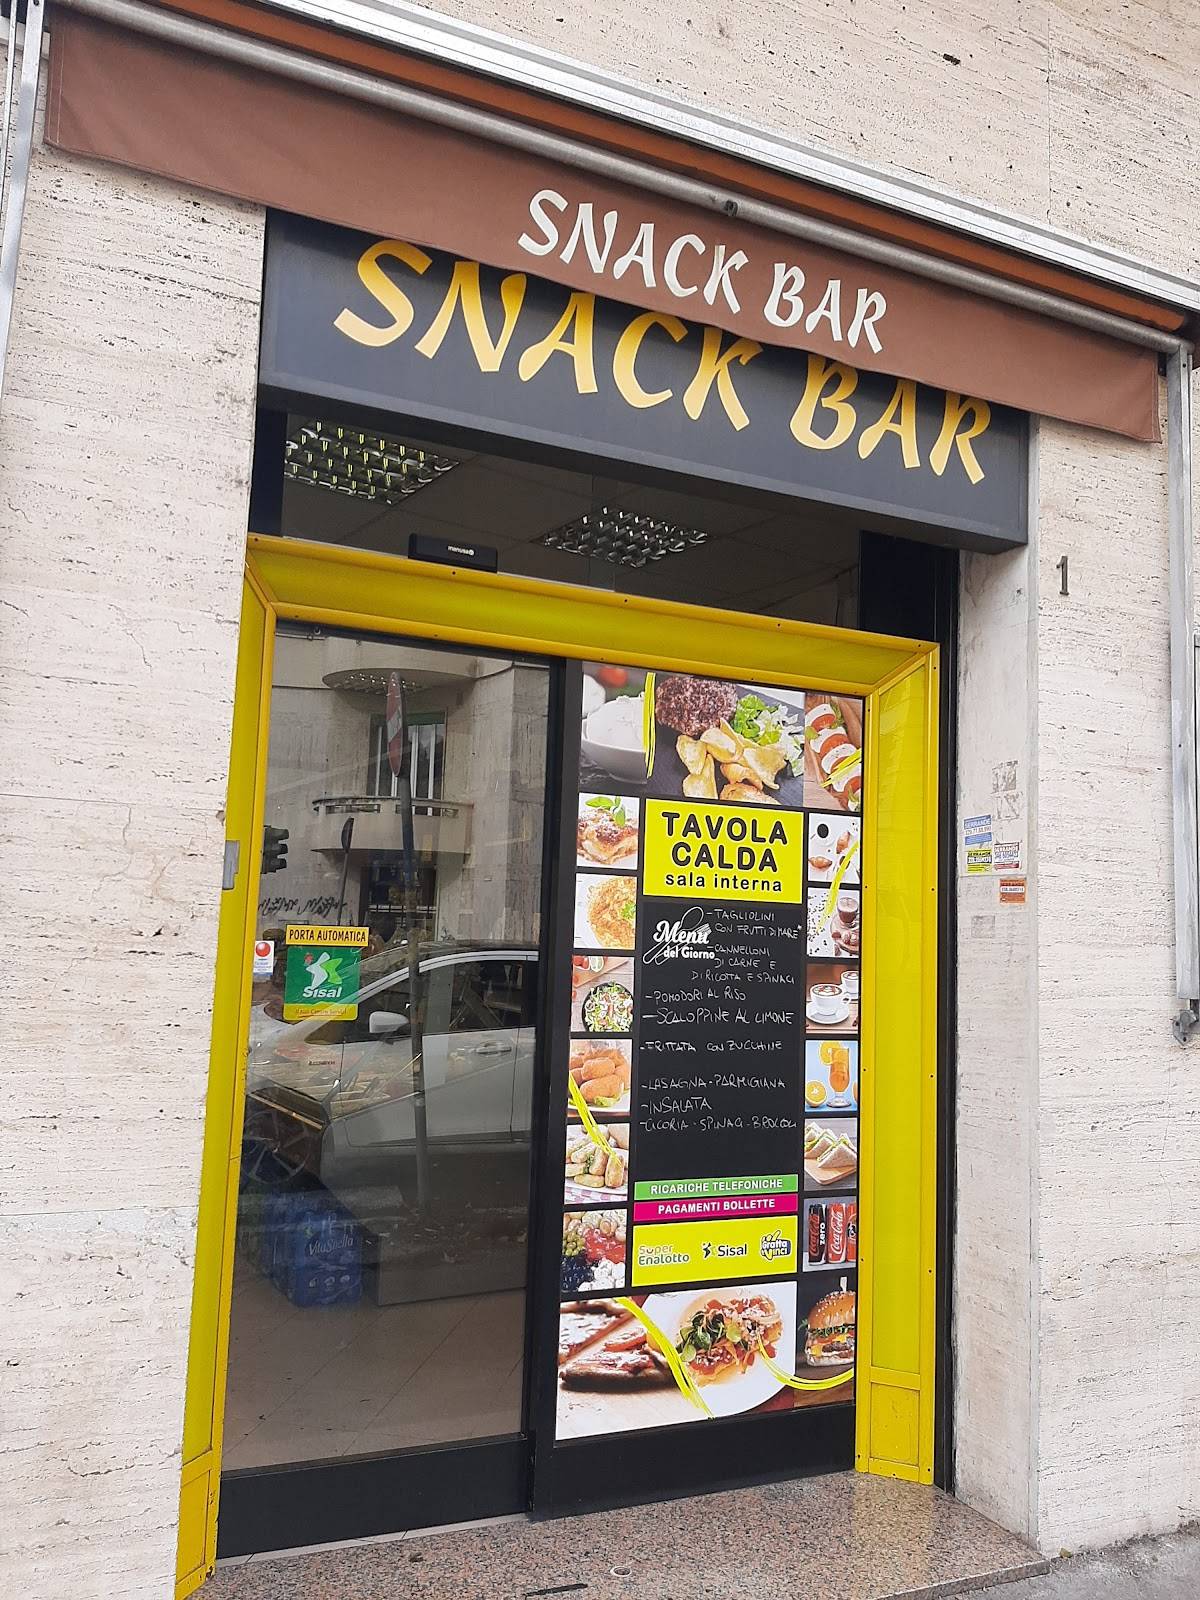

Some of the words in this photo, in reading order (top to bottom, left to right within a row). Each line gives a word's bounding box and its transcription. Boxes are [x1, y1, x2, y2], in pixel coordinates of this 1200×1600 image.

[517, 189, 749, 314] SNACK
[762, 261, 886, 354] BAR
[333, 238, 765, 432] SNACK
[789, 353, 992, 485] BAR
[1056, 555, 1069, 595] 1
[661, 812, 788, 845] TAVOLA
[672, 841, 778, 872] CALDA
[665, 871, 705, 888] sala
[714, 873, 782, 892] interna
[289, 929, 314, 940] PORTA
[317, 930, 366, 942] AUTOMATICA
[715, 924, 733, 933] CON
[736, 924, 766, 936] FRUTTI
[663, 945, 679, 958] del
[681, 946, 715, 959] Giorno
[714, 958, 724, 968] DI
[728, 958, 760, 968] CARNE
[770, 960, 777, 970] E
[705, 968, 741, 982] RICOTTA
[757, 972, 794, 984] SPINACI
[303, 986, 343, 998] Sisal
[707, 988, 719, 998] AL
[724, 985, 747, 1000] RISO
[735, 1008, 750, 1024] AL
[755, 1012, 795, 1025] LIMONE
[707, 1042, 724, 1051] CON
[727, 1040, 782, 1051] ZUCCHINE
[651, 1183, 709, 1195] RICARICHE
[712, 1178, 783, 1192] TELEFONICHE
[657, 1202, 720, 1215] PAGAMENTI
[723, 1199, 776, 1210] BOLLETTE
[638, 1244, 673, 1255] Super
[717, 1244, 747, 1257] Sisal
[762, 1240, 787, 1249] Gratta
[638, 1253, 690, 1266] Enalotto
